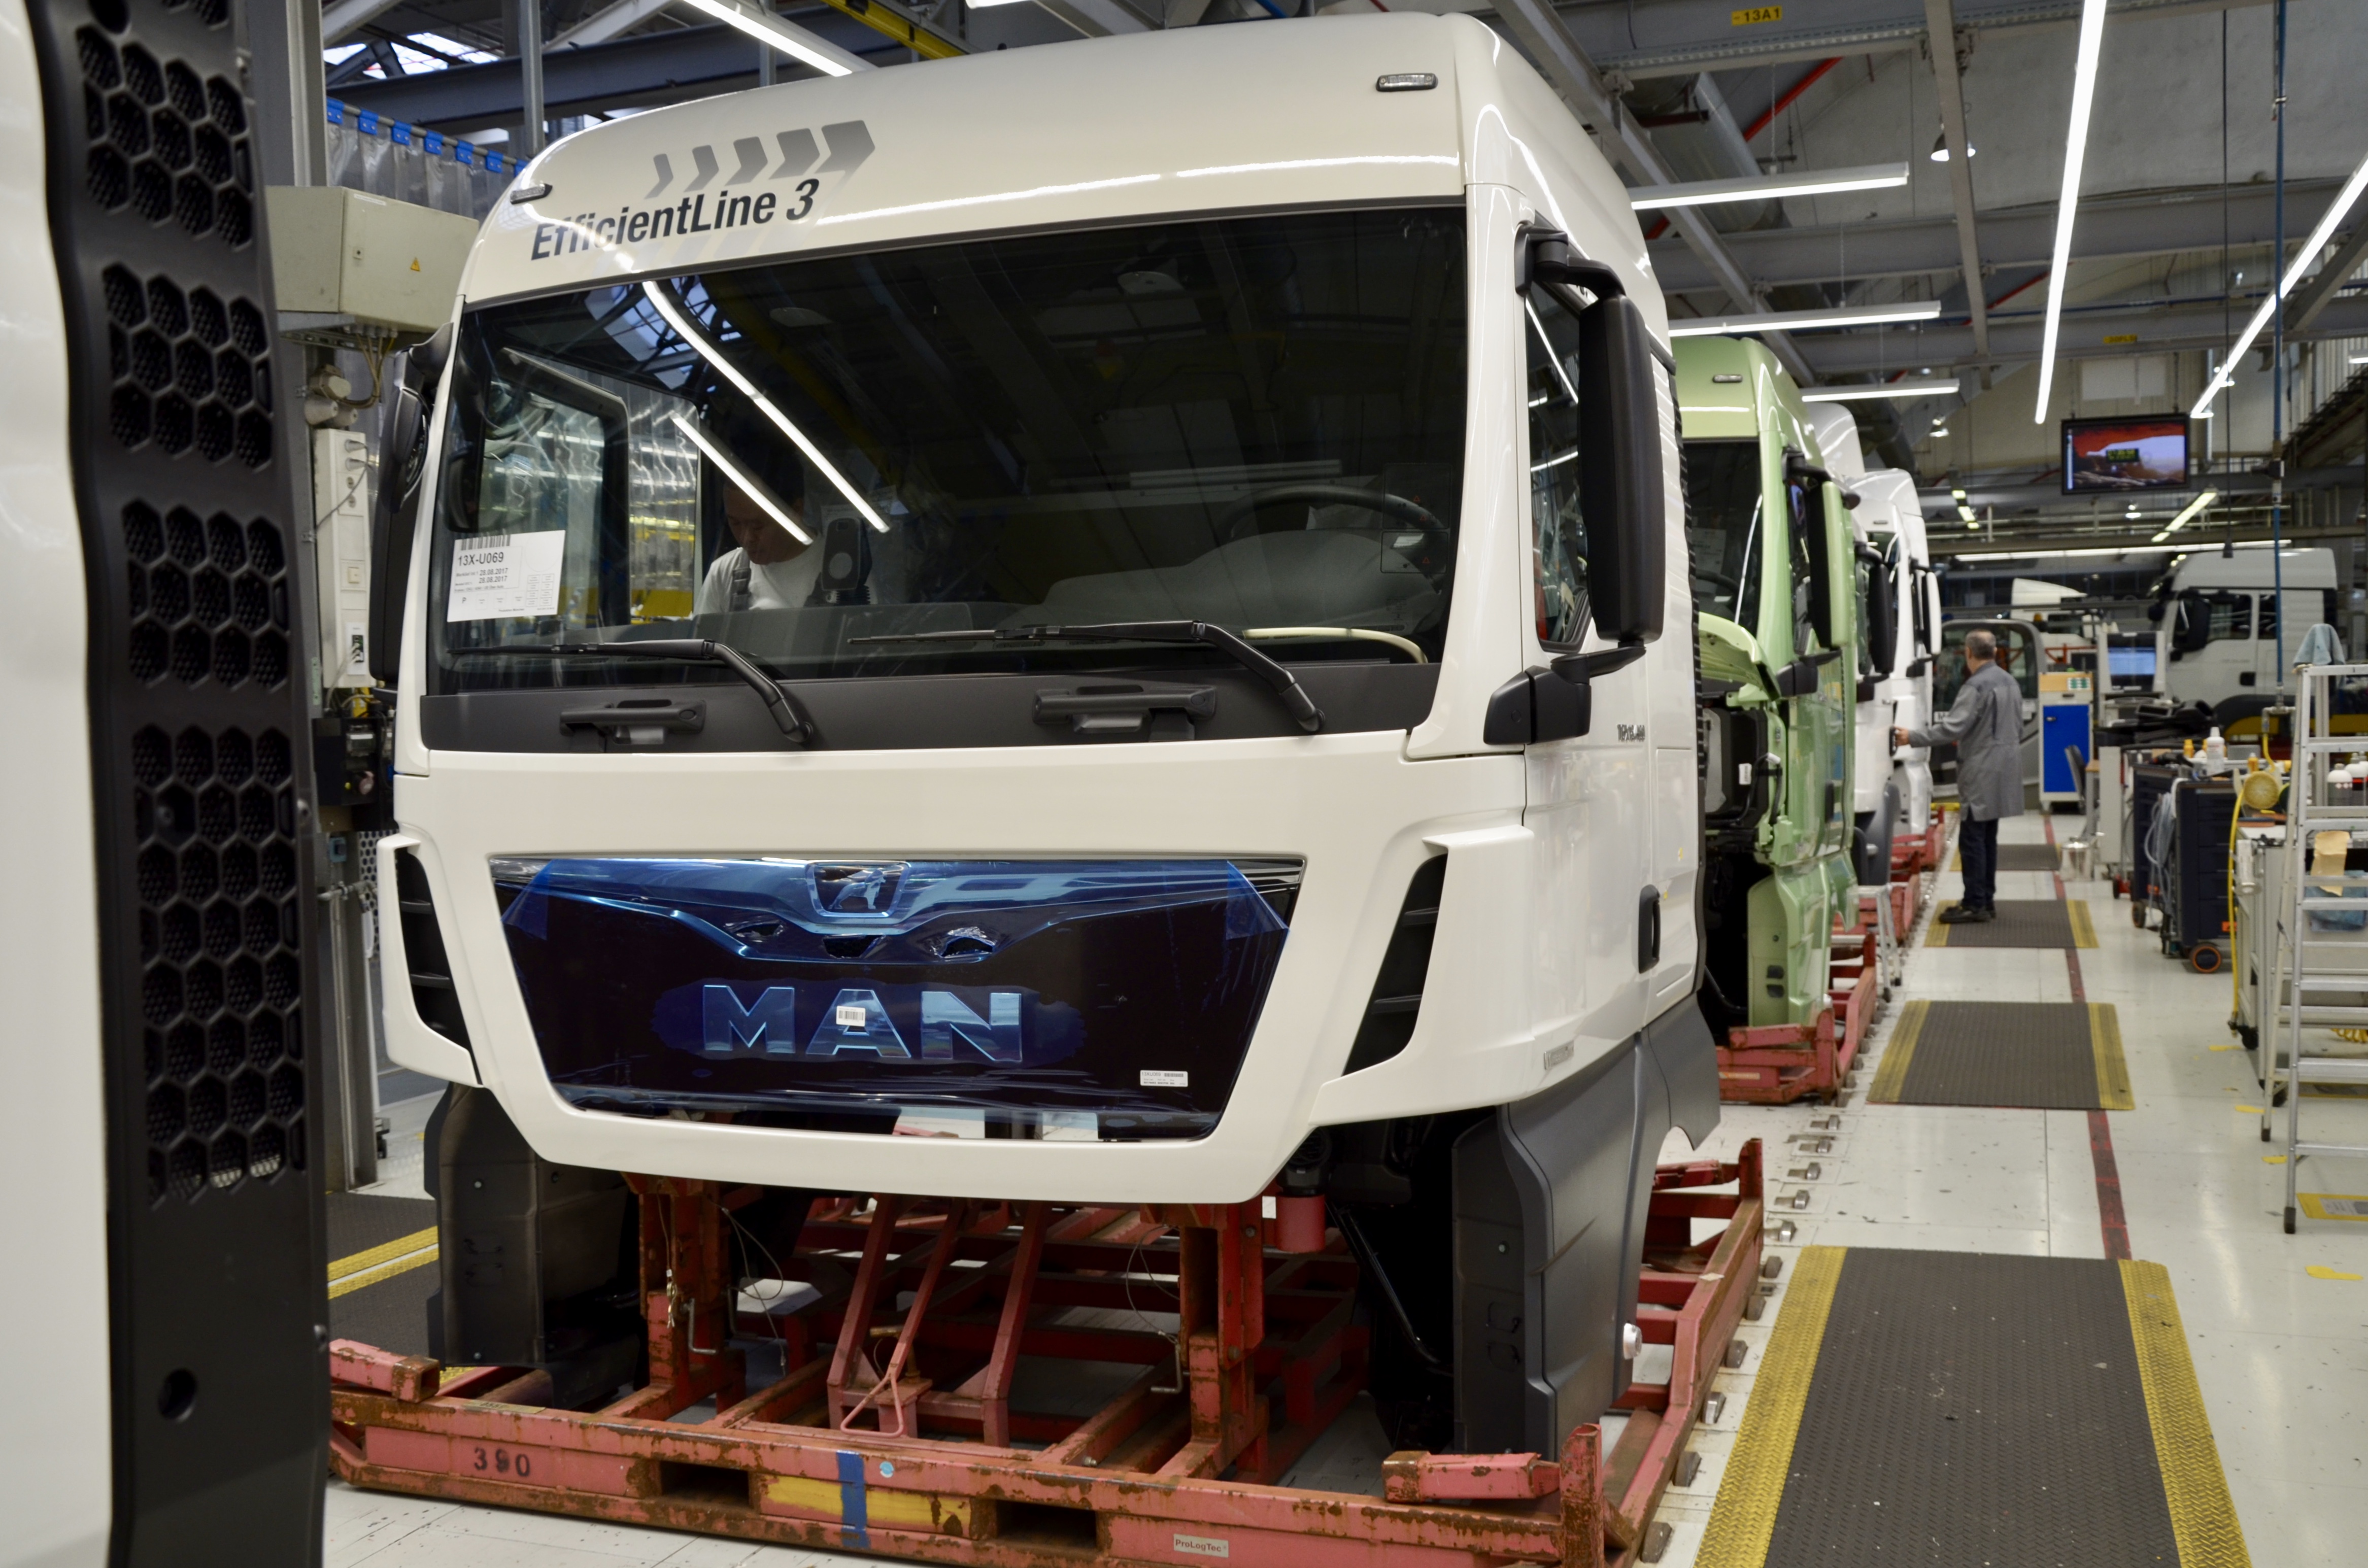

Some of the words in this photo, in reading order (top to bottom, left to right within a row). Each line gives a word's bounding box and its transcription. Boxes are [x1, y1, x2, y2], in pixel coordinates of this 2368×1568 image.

[531, 190, 777, 260] EfficientLine
[786, 178, 820, 221] 3
[458, 552, 504, 566] 13X-U069
[703, 985, 1022, 1062] MAN
[1175, 1539, 1222, 1552] ProLogTec
